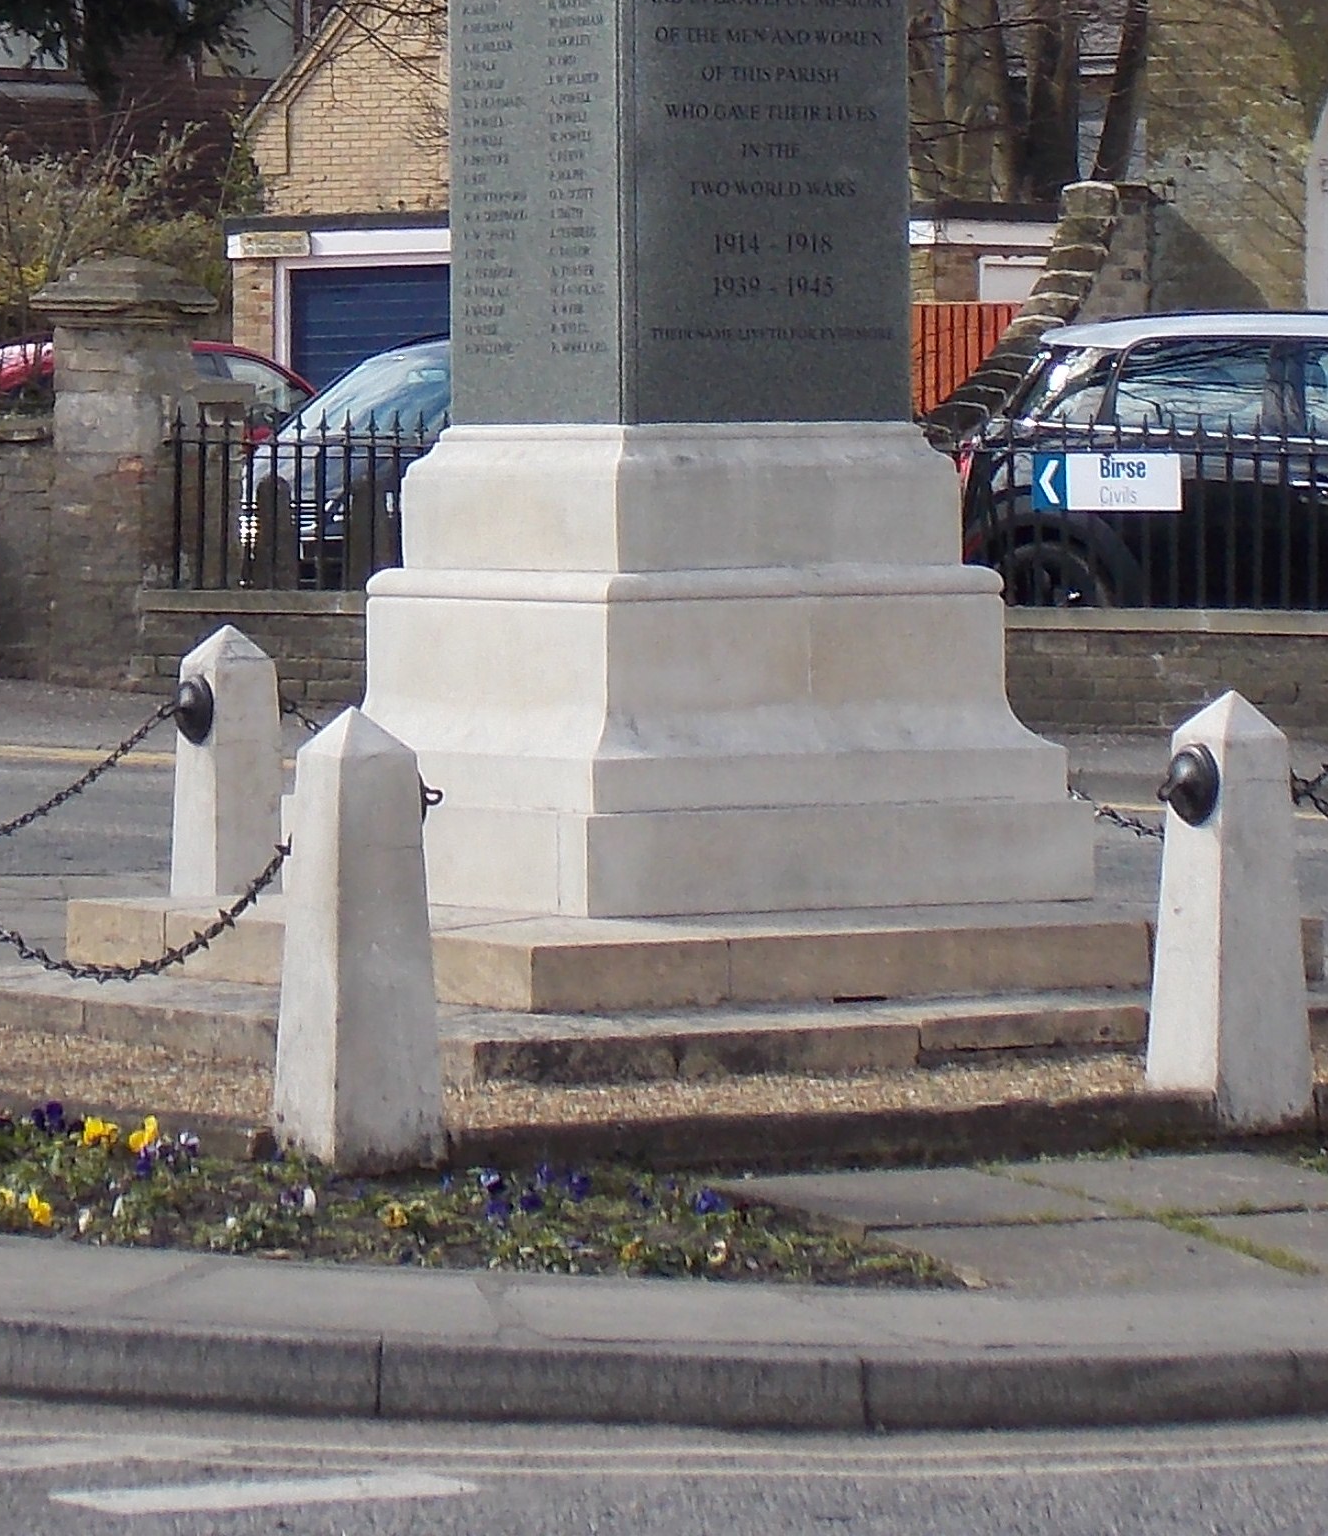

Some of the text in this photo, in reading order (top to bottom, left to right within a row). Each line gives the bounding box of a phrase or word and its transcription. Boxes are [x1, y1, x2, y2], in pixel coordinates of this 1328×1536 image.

[655, 27, 883, 47] OF THE MEN AND WOMEN
[701, 66, 840, 83] OF THIS PARISH
[665, 103, 878, 122] WHO GAVE THEIR LIVES
[741, 143, 801, 159] IN THE
[688, 180, 857, 197] TWO WORLD WARS
[714, 233, 761, 254] 1914
[786, 233, 834, 254] 1918
[713, 276, 761, 298] 1939
[787, 276, 835, 298] 1945
[1100, 457, 1146, 478] Birse
[1099, 485, 1139, 504] Civils
